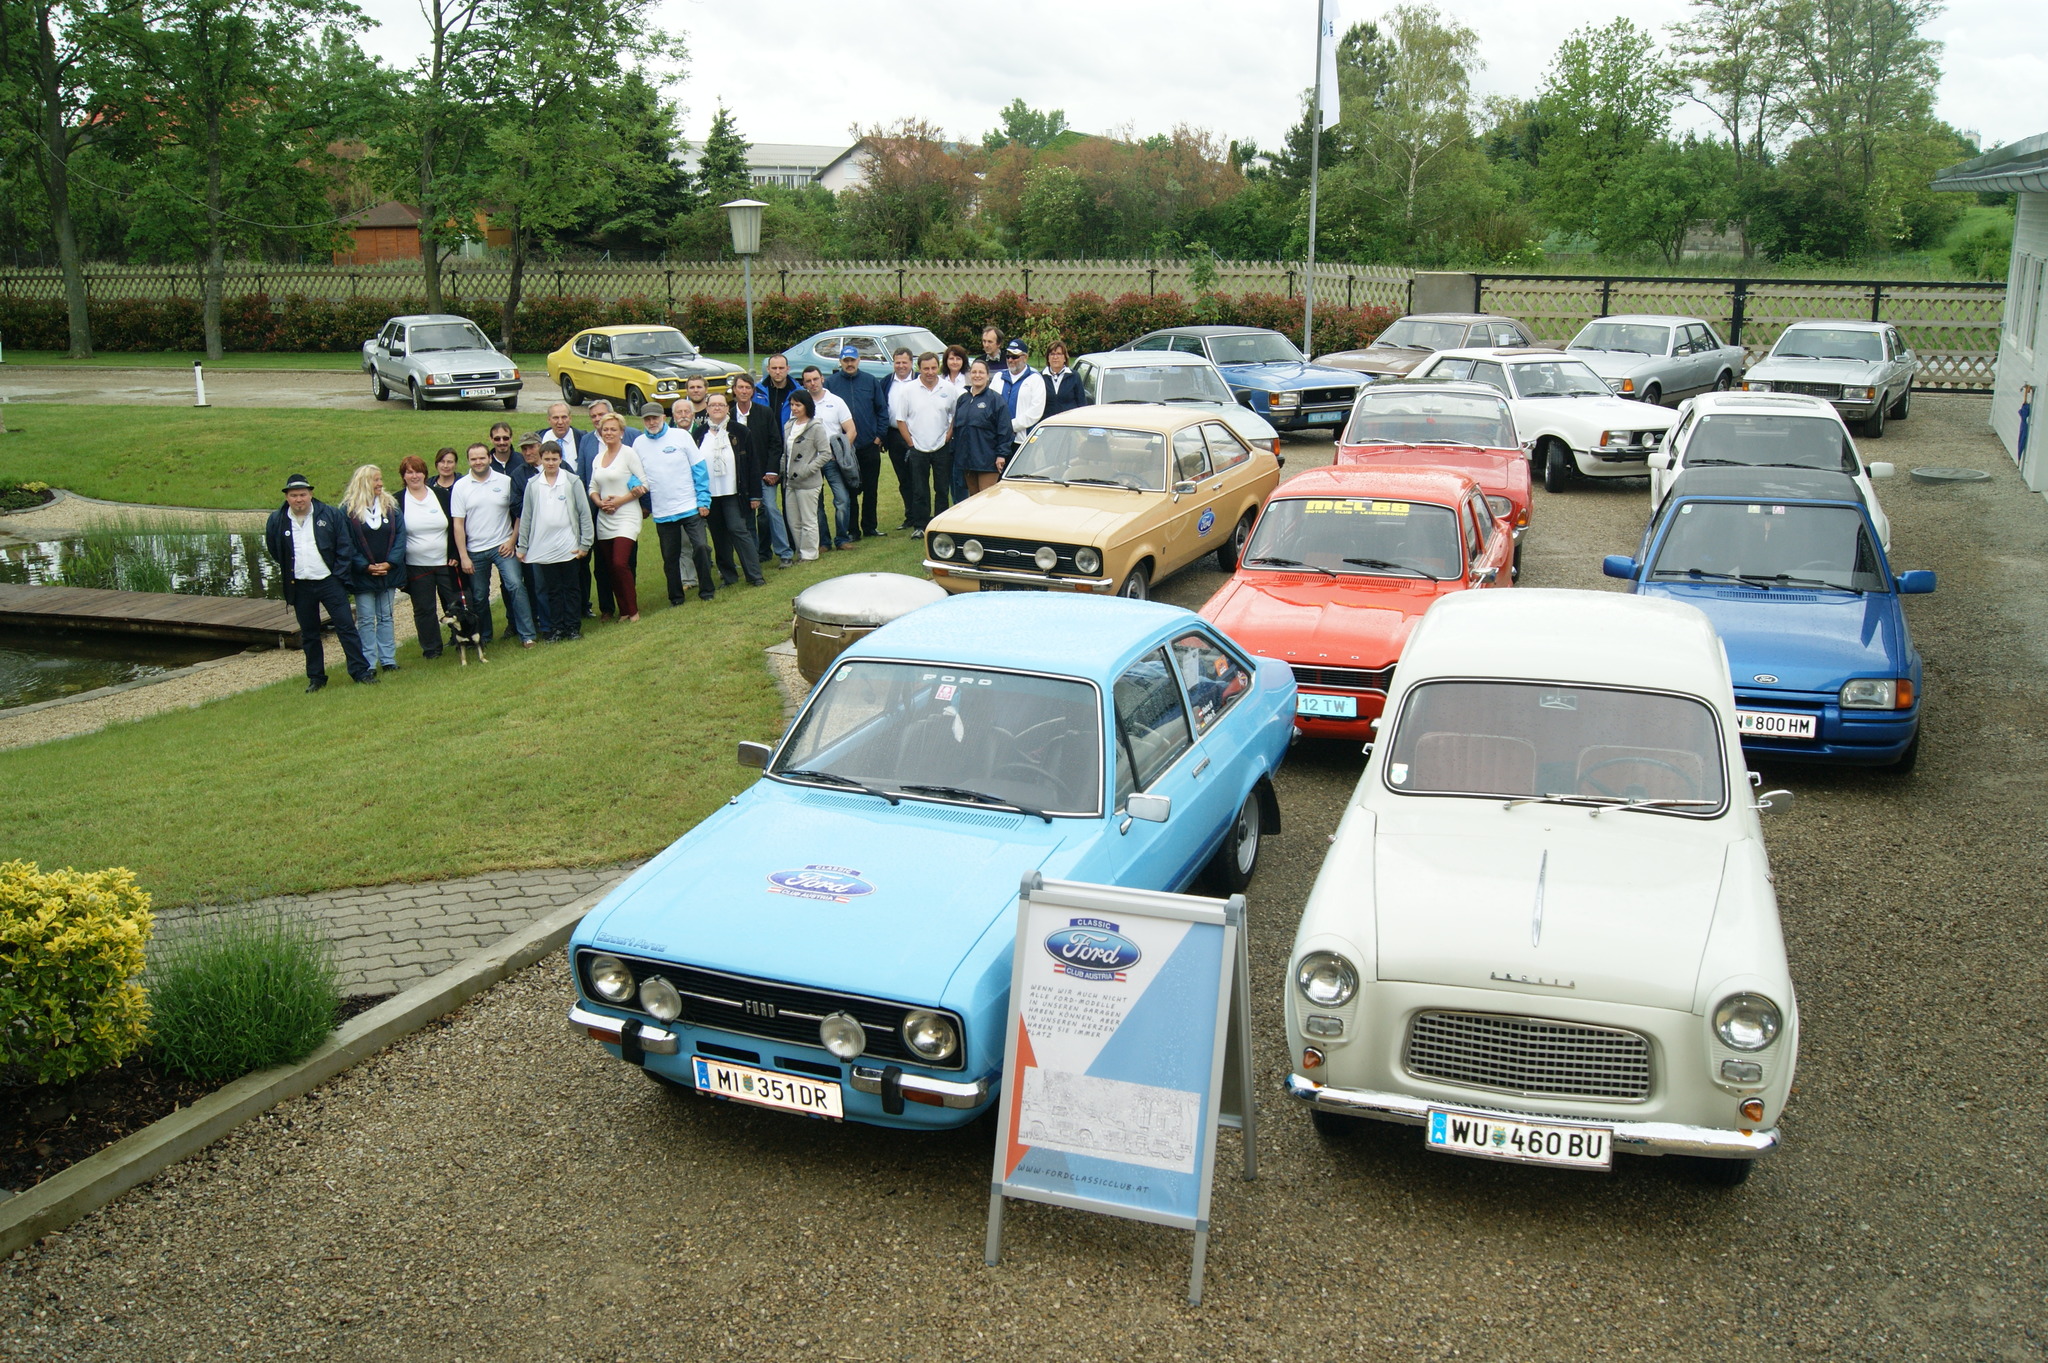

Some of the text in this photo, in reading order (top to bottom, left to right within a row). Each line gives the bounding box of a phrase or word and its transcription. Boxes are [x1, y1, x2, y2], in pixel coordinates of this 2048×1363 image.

[1372, 502, 1410, 513] 68
[922, 673, 993, 686] FORD
[1302, 698, 1346, 713] 12 TW
[1755, 716, 1785, 732] 800
[1788, 718, 1810, 733] HM
[785, 872, 856, 893] Ford
[781, 889, 834, 901] CLUB AUSTRIA
[1077, 919, 1111, 930] CLASSIC
[1062, 932, 1122, 964] Ford
[1066, 967, 1113, 980] CLUB AUSTRIA
[1029, 991, 1116, 1010] ALLE FORD-MODELLE
[1030, 984, 1054, 993] WENN
[1076, 991, 1098, 999] AUCH
[1102, 994, 1128, 1003] NICHT
[745, 999, 775, 1018] FORD
[1028, 1006, 1054, 1016] HABEN
[1099, 1017, 1121, 1025] ABER
[1042, 1001, 1079, 1012] UNSEREN
[1083, 1006, 1121, 1018] GARAGEN
[1027, 1021, 1101, 1038] HABEN SIE IMMER
[1040, 1016, 1078, 1027] UNSEREN
[1081, 1022, 1115, 1033] HERZEN
[1026, 1029, 1052, 1039] PLATZ
[701, 1077, 708, 1086] A
[717, 1068, 739, 1093] MI
[1434, 1131, 1444, 1141] A
[1452, 1118, 1489, 1147] WU
